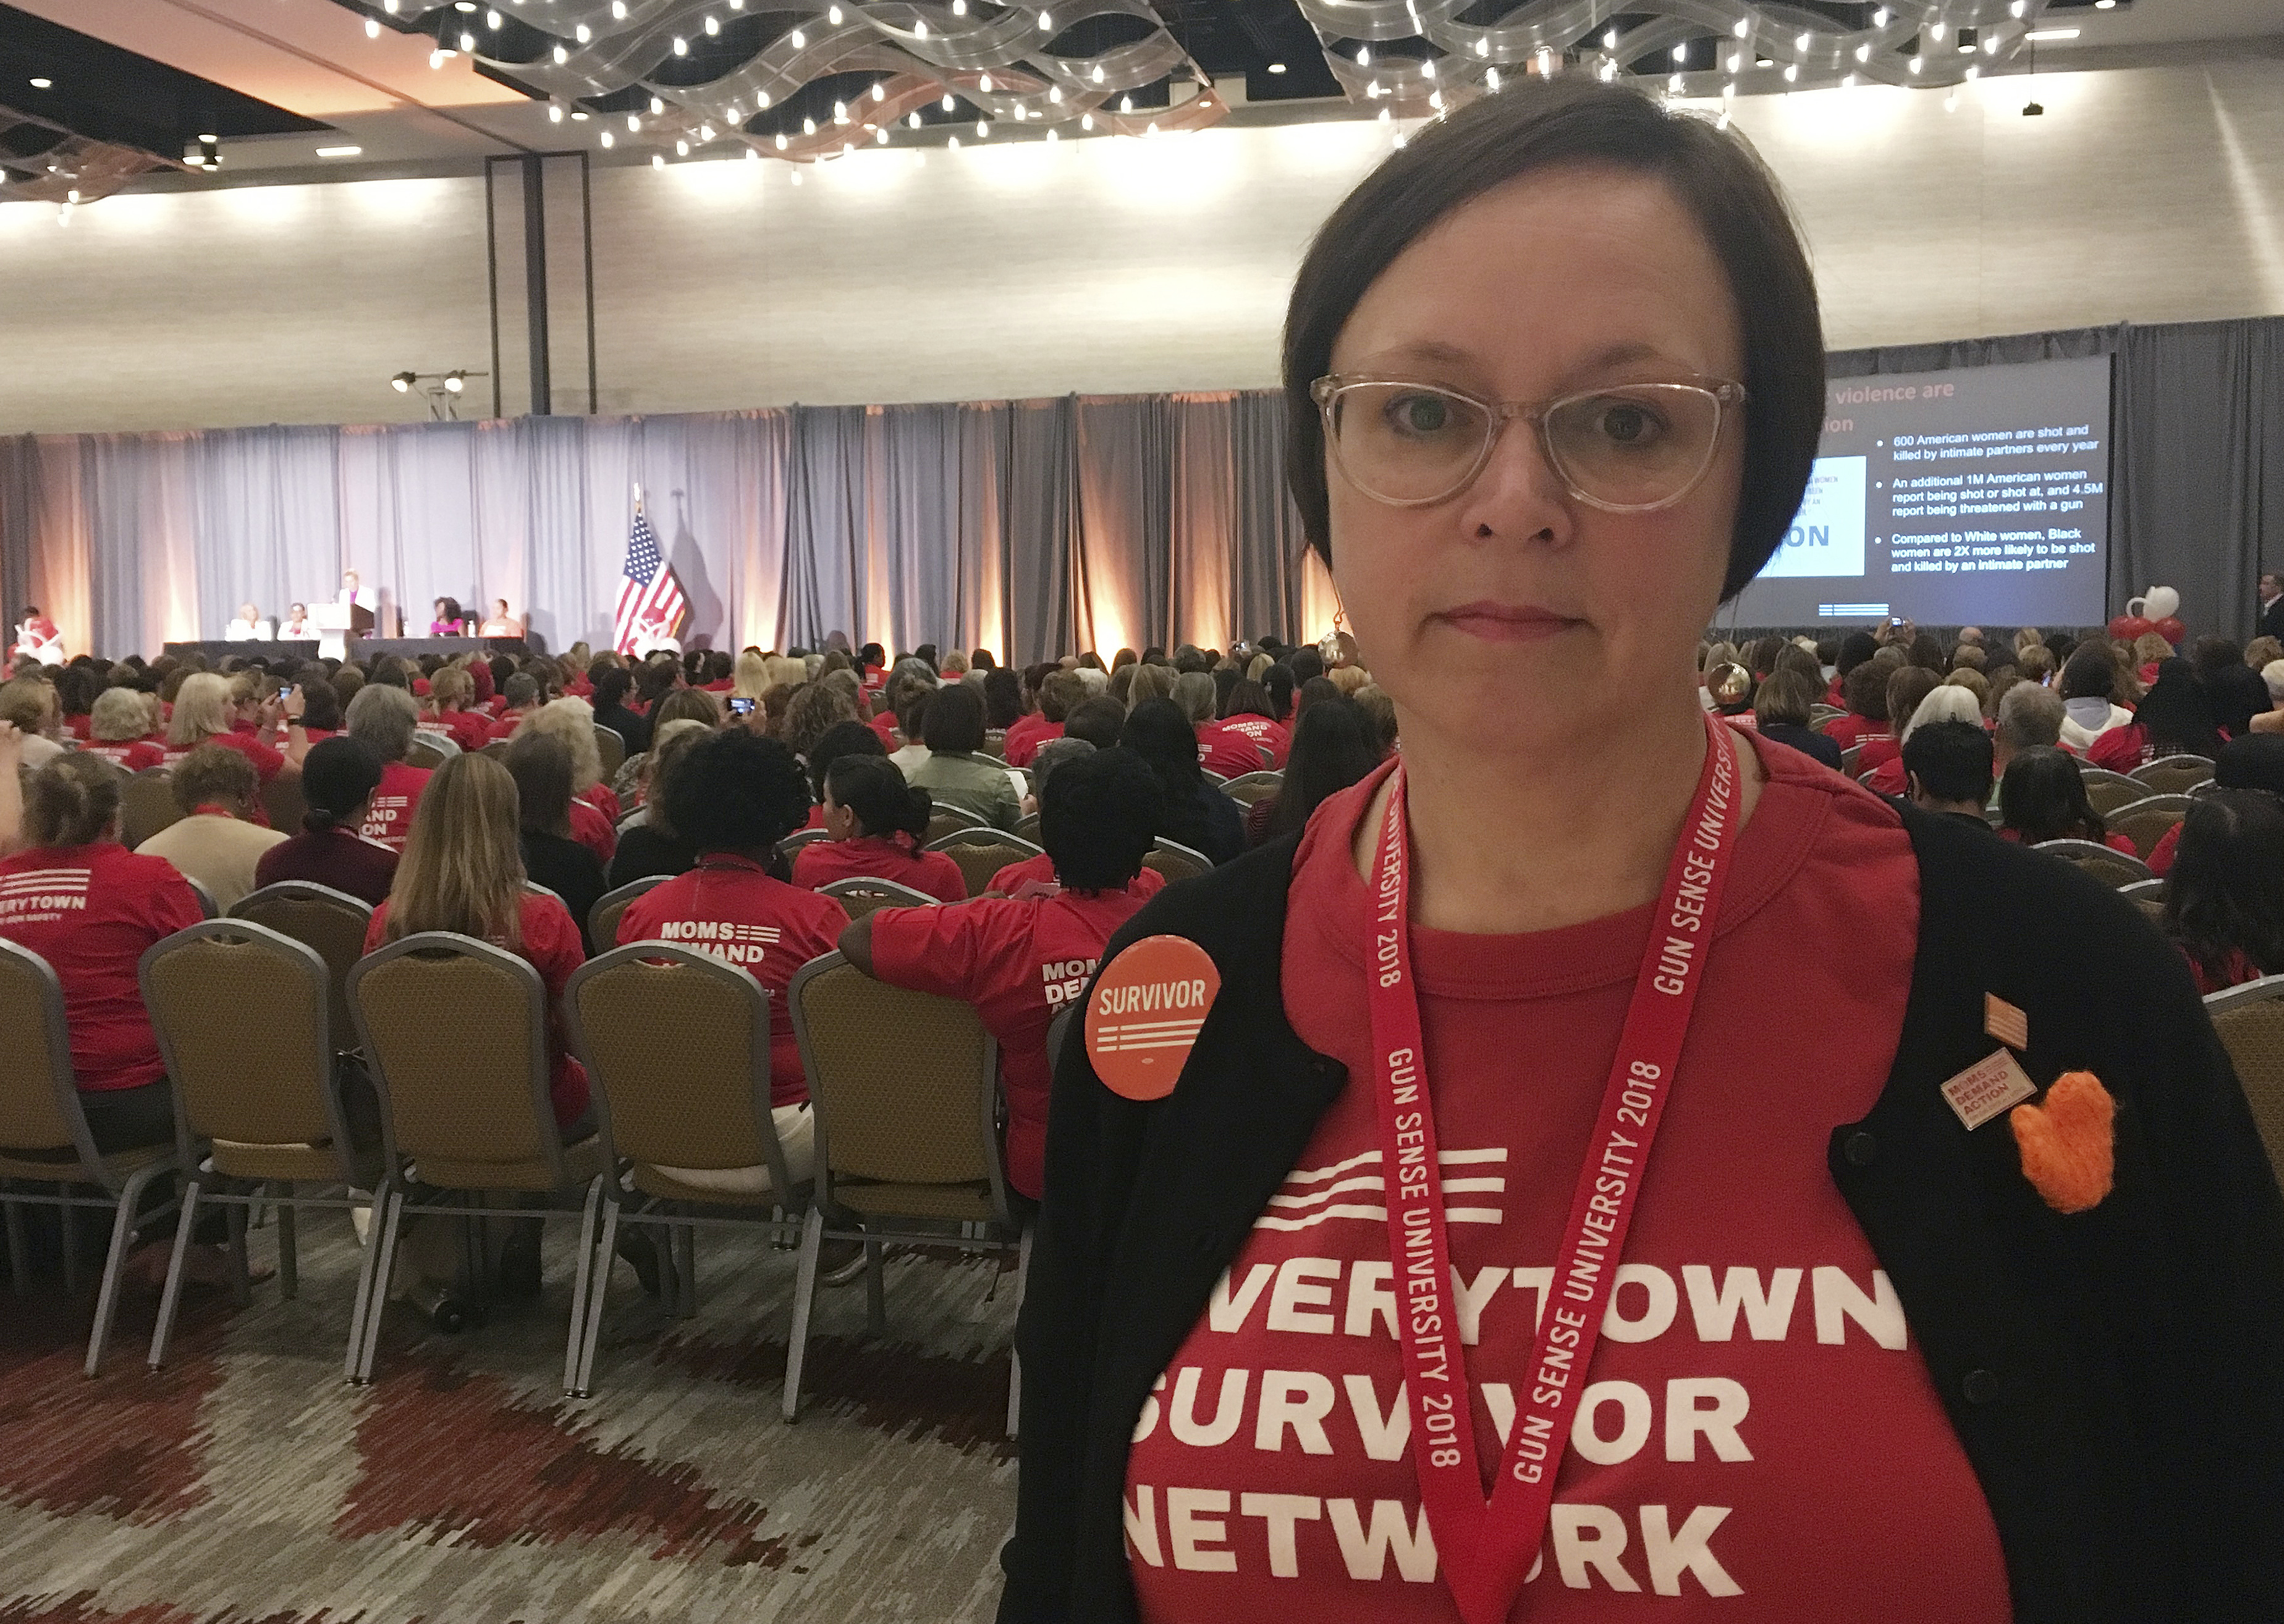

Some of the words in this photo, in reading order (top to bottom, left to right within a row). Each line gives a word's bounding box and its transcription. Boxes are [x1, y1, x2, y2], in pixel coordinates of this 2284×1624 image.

[1835, 386, 1916, 404] violence
[1922, 384, 1955, 399] are
[1893, 435, 1914, 447] 600
[1916, 433, 1969, 445] American
[1971, 431, 2013, 442] women
[2015, 429, 2035, 439] are
[2037, 426, 2063, 438] shot
[2066, 424, 2089, 436] and
[1893, 449, 1921, 461] killed
[1924, 449, 1937, 461] by
[1940, 447, 1984, 459] intimate
[1986, 444, 2034, 458] partners
[2036, 442, 2070, 454] every
[2071, 440, 2100, 454] year
[1892, 478, 1908, 488] An
[1911, 475, 1963, 488] additional
[1966, 473, 1984, 484] 1M
[1986, 472, 2041, 484] American
[2044, 470, 2087, 481] women
[1892, 491, 1924, 504] report
[1927, 489, 1957, 503] being
[1960, 489, 1984, 500] shot
[1987, 489, 1999, 499] or
[2002, 487, 2026, 498] shot
[2029, 486, 2044, 497] at,
[2047, 484, 2070, 495] and
[2072, 482, 2104, 494] 4.5M
[1892, 505, 1924, 518] report
[1926, 504, 1957, 517] being
[1960, 501, 2020, 514] threatened
[2023, 499, 2047, 511] with
[2049, 501, 2058, 510] a
[2060, 500, 2084, 512] gun
[1891, 548, 1931, 558] women
[1933, 548, 1952, 557] are
[1953, 545, 1970, 556] 2X
[1972, 546, 2002, 556] more
[2004, 543, 2034, 557] likely
[2036, 544, 2049, 554] to
[2051, 543, 2066, 554] be
[2069, 542, 2096, 553] shot
[1892, 532, 1948, 545] Compared
[1951, 532, 1963, 543] to
[1965, 530, 1997, 542] White
[1999, 531, 2045, 541] women,
[2048, 528, 2082, 540] Black
[1891, 560, 1912, 572] and
[1914, 560, 1942, 572] killed
[1945, 560, 1960, 573] by
[1961, 561, 1976, 571] an
[1978, 559, 2024, 570] intimate
[2026, 559, 2069, 572] partner
[1670, 850, 1715, 932] SENSE
[661, 921, 735, 941] MOMS
[1376, 928, 1402, 989] 2018
[1653, 936, 1694, 996] GUN
[1099, 979, 1206, 1015] SURVIVOR
[1388, 1047, 1419, 1106] GUN
[1616, 1060, 1662, 1128] 2018
[1948, 1070, 1987, 1096] MOMS
[1955, 1070, 2008, 1106] DEMAND
[1964, 1083, 2008, 1115] ACTION
[1395, 1112, 1429, 1201] SENSE
[1563, 1130, 1639, 1303] UNIVERSITY
[1402, 1208, 1449, 1382] UNIVERSITY
[1533, 1306, 1587, 1410] SENSE
[1130, 1366, 1755, 1465] URVOR
[1422, 1393, 1461, 1468] 2018
[1513, 1415, 1554, 1484] GUN
[1123, 1484, 1746, 1597] NETWRK
